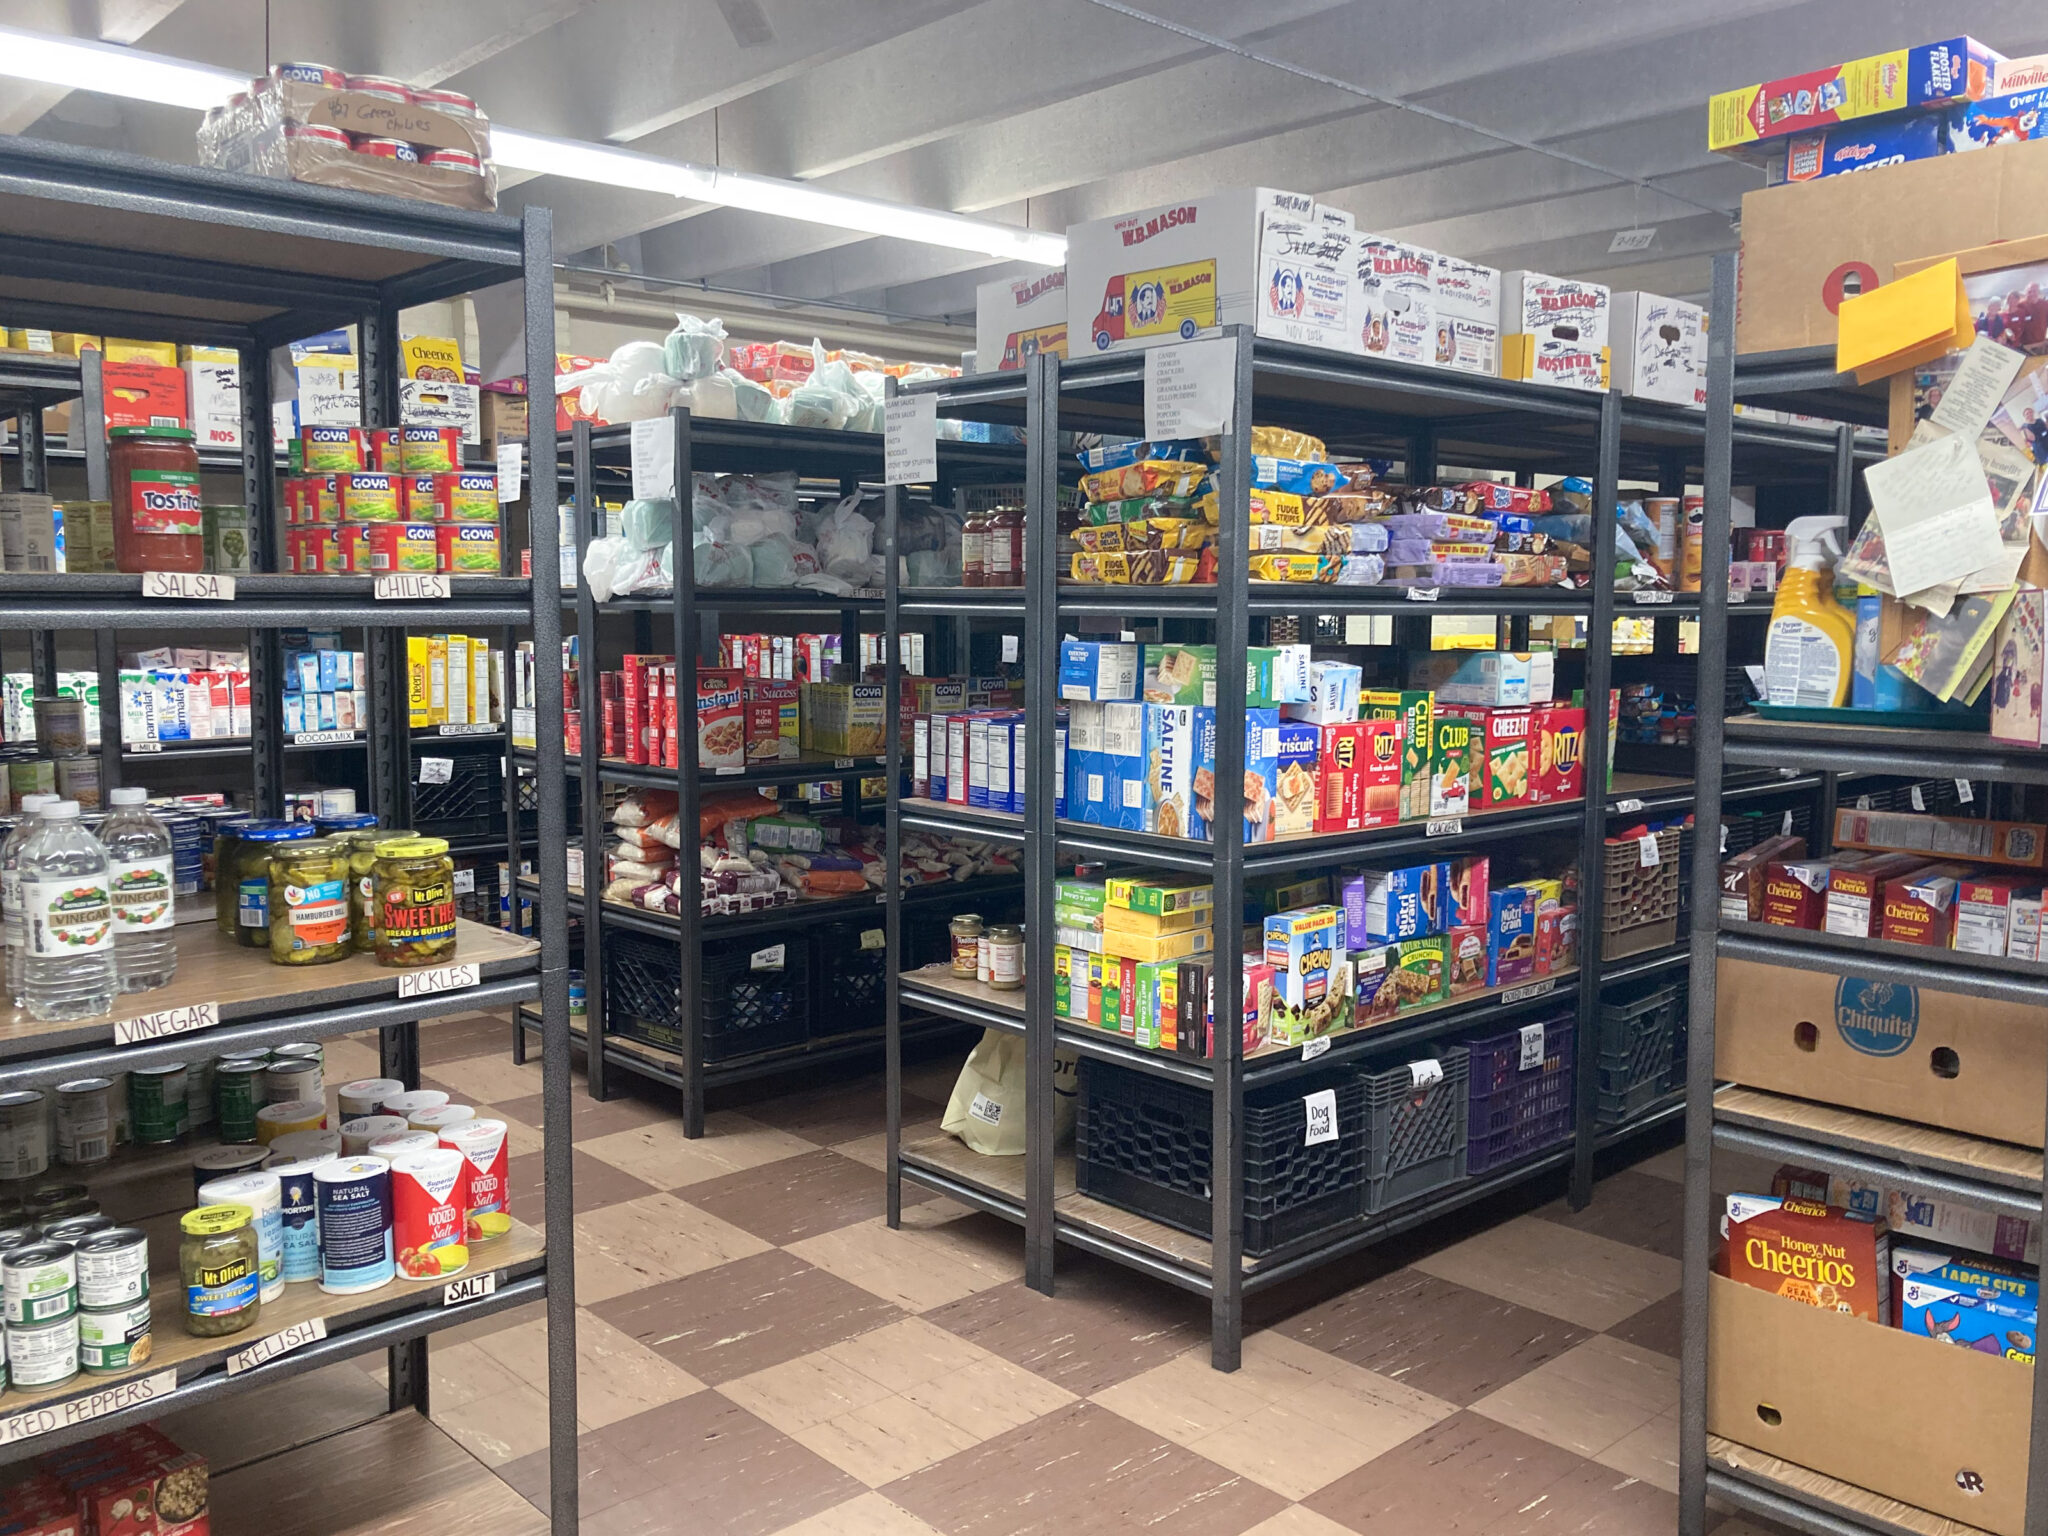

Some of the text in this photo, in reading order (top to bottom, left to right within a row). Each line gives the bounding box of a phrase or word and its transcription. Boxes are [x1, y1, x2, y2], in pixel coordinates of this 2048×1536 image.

[283, 68, 322, 82] GOYA
[1930, 51, 1941, 88] FLAKES
[1938, 46, 1952, 91] FROSTED
[2000, 72, 2048, 90] Millville
[2010, 94, 2036, 109] Over
[1834, 144, 1876, 162] Kellogg's
[1793, 166, 1817, 176] SPORTS
[1794, 160, 1817, 169] SCHOOL
[1122, 206, 1198, 247] W.B.MASON
[1304, 272, 1347, 288] FLAGSHIP
[1390, 317, 1426, 331] FLAGSHIP
[1456, 322, 1495, 336] FLAGSHIP
[412, 346, 454, 362] Cheerios
[1158, 352, 1177, 360] CANDY
[1157, 360, 1180, 368] COOKIES
[1156, 368, 1184, 376] CRACKERS
[1157, 384, 1182, 393] GRANOLA
[900, 399, 915, 407] SAUCE
[902, 410, 916, 418] SAUCE
[1157, 410, 1180, 419] POPCORN
[312, 429, 349, 442] GOYA
[404, 429, 438, 442] GOYA
[352, 478, 388, 490] GOYA
[460, 478, 494, 490] GOYA
[1276, 504, 1299, 514] FUDGE
[1276, 513, 1300, 523] STRIPES
[461, 528, 494, 540] GOYA
[1100, 530, 1118, 538] CHIPS
[1104, 560, 1124, 568] FUDGE
[1104, 568, 1126, 577] STRIPES
[152, 572, 220, 597] SALSA
[1299, 654, 1307, 692] SALTINE
[411, 664, 422, 703] Cheerios
[982, 679, 1006, 690] GOYA
[854, 686, 882, 698] GOYA
[936, 686, 962, 696] GOYA
[144, 692, 156, 740] parmalat
[175, 688, 188, 736] parmalat
[1373, 708, 1396, 720] CLUB
[442, 726, 476, 734] CEREAL
[1416, 700, 1428, 748] CLUB
[1492, 717, 1528, 738] CHEEZ-IT
[297, 734, 333, 744] COCOA
[1440, 725, 1468, 750] CLUB
[1162, 709, 1174, 794] SALTINE
[1278, 739, 1314, 754] triscuit
[1338, 736, 1355, 769] RITZ
[1374, 735, 1395, 756] RITZ
[1553, 731, 1579, 766] RITZ
[1370, 764, 1384, 772] fresh
[1428, 822, 1460, 834] CRACKERS
[1767, 884, 1802, 900] Cheerios
[1833, 880, 1867, 894] Cheerios
[115, 892, 165, 904] VINEGAR
[306, 890, 320, 899] NO
[414, 887, 444, 903] Mt. Olive
[56, 909, 109, 925] VINEGAR
[296, 909, 334, 921] HAMBURGER
[384, 903, 436, 928] SWEET
[1399, 895, 1408, 936] Nutri
[1407, 893, 1416, 935] Grain
[1501, 904, 1522, 922] Nutri
[1886, 905, 1930, 923] Cheerios
[386, 925, 448, 938] BREAD & BUTTER
[1295, 919, 1325, 931] VALUE PACK
[1501, 918, 1522, 934] Grain
[1422, 938, 1441, 950] VALLEY
[1300, 948, 1332, 976] CHEWY
[1408, 952, 1434, 962] CRUNCHY
[402, 966, 473, 996] PICKLES
[119, 1004, 214, 1043] VINEGAR
[1838, 1006, 1913, 1039] Chiquita
[1524, 1061, 1537, 1069] Free
[1311, 1106, 1329, 1124] Dog
[1310, 1122, 1329, 1136] Food
[470, 1147, 498, 1158] Superior
[472, 1154, 496, 1163] Crystal
[426, 1176, 455, 1188] Superior
[428, 1183, 454, 1193] Crystal
[471, 1177, 498, 1192] IODIZED
[332, 1186, 369, 1195] NATURAL
[351, 1191, 370, 1200] SALT
[474, 1191, 494, 1206] Salt
[282, 1205, 313, 1214] MORTON
[1784, 1201, 1827, 1217] Cheerios
[428, 1210, 456, 1226] IODIZED
[432, 1224, 452, 1240] Salt
[1781, 1236, 1846, 1260] Honey Nut
[1746, 1238, 1856, 1288] Cheerios
[204, 1264, 245, 1286] Mt. Olive
[194, 1284, 254, 1302] SWEET RELISH
[449, 1276, 490, 1300] SALT
[1787, 1287, 1813, 1298] REAL
[238, 1320, 316, 1370] RELISH
[10, 1380, 154, 1438] RED PEPPERS
